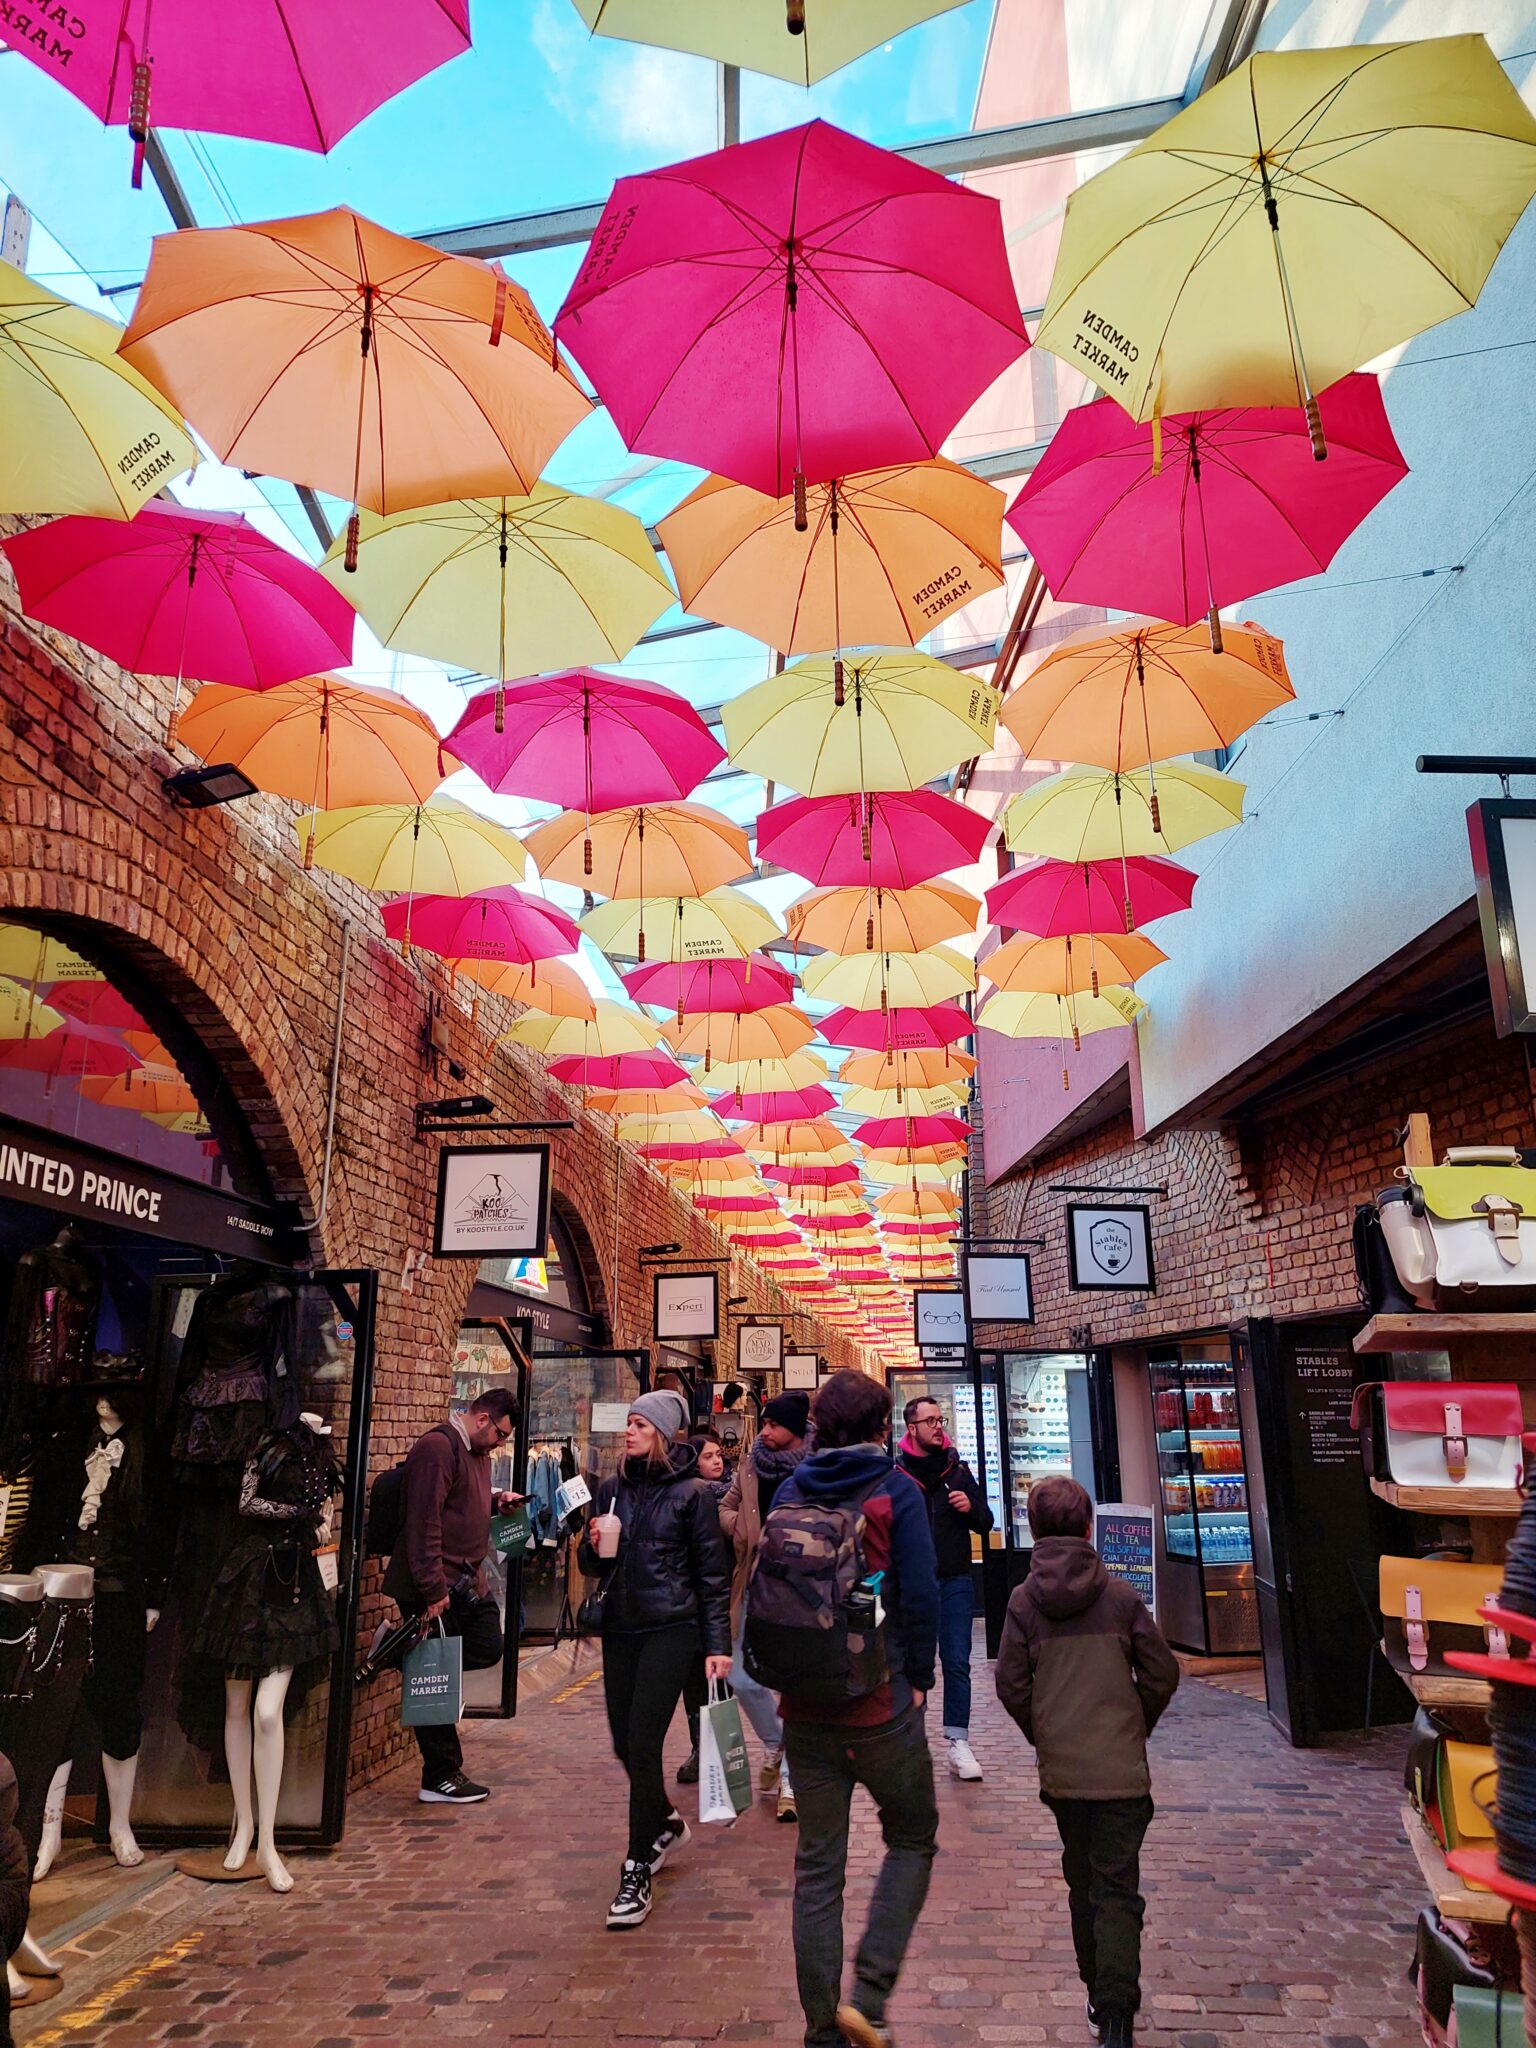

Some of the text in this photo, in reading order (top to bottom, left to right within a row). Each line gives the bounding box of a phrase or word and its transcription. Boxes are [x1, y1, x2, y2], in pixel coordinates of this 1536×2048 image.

[0, 1144, 162, 1223] INTED PRINCE
[482, 1198, 502, 1209] KOO
[473, 1208, 509, 1219] PATCHES
[238, 1219, 260, 1233] SADDLE
[260, 1225, 274, 1236] ROW
[456, 1224, 525, 1234] BY KOOSTYLE.CO.UK
[1095, 1234, 1128, 1248] Stables
[1104, 1243, 1122, 1252] Cafe
[668, 1301, 703, 1312] Expert
[532, 1309, 550, 1330] STYLE
[751, 1339, 771, 1348] MAD
[745, 1346, 777, 1356] HATTERS
[1296, 1356, 1339, 1365] STABLES
[1297, 1368, 1354, 1377] LIFT LOBBY
[499, 1524, 523, 1538] CAMDEN
[1105, 1523, 1150, 1536] ALL COFFEE
[500, 1530, 524, 1544] MARKET
[1104, 1534, 1139, 1545] ALL TEA
[1103, 1545, 1115, 1553] ALL
[1117, 1546, 1134, 1554] SOFT
[1102, 1554, 1148, 1564] CHAI LATTE
[410, 1675, 449, 1685] CAMDEN
[410, 1685, 449, 1696] MARKET
